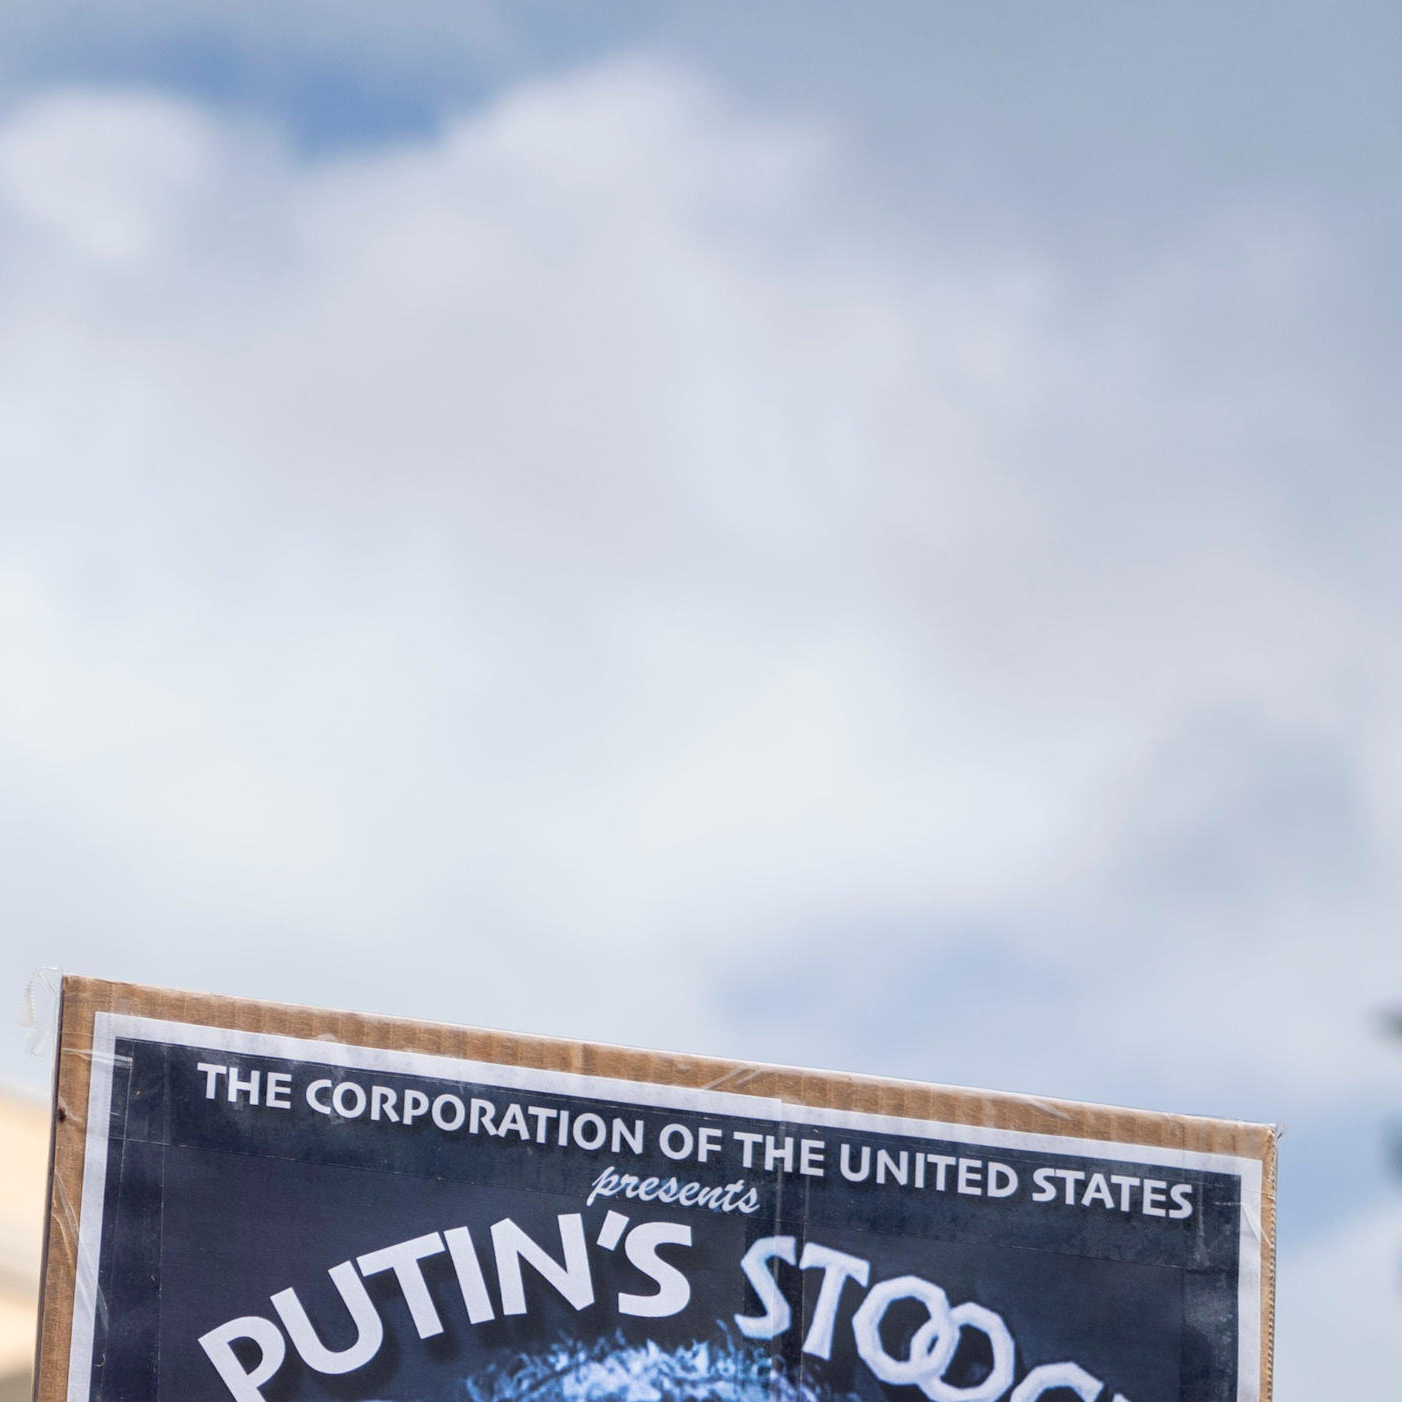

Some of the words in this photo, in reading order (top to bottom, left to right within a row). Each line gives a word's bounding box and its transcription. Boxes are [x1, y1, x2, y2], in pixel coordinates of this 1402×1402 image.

[197, 1062, 293, 1109] THE
[305, 1078, 644, 1155] CORPORATION
[659, 1123, 722, 1162] OF
[734, 1132, 825, 1176] THE
[839, 1144, 1019, 1198] UNITED
[1032, 1168, 1193, 1219] STATES
[588, 1165, 761, 1214] presents
